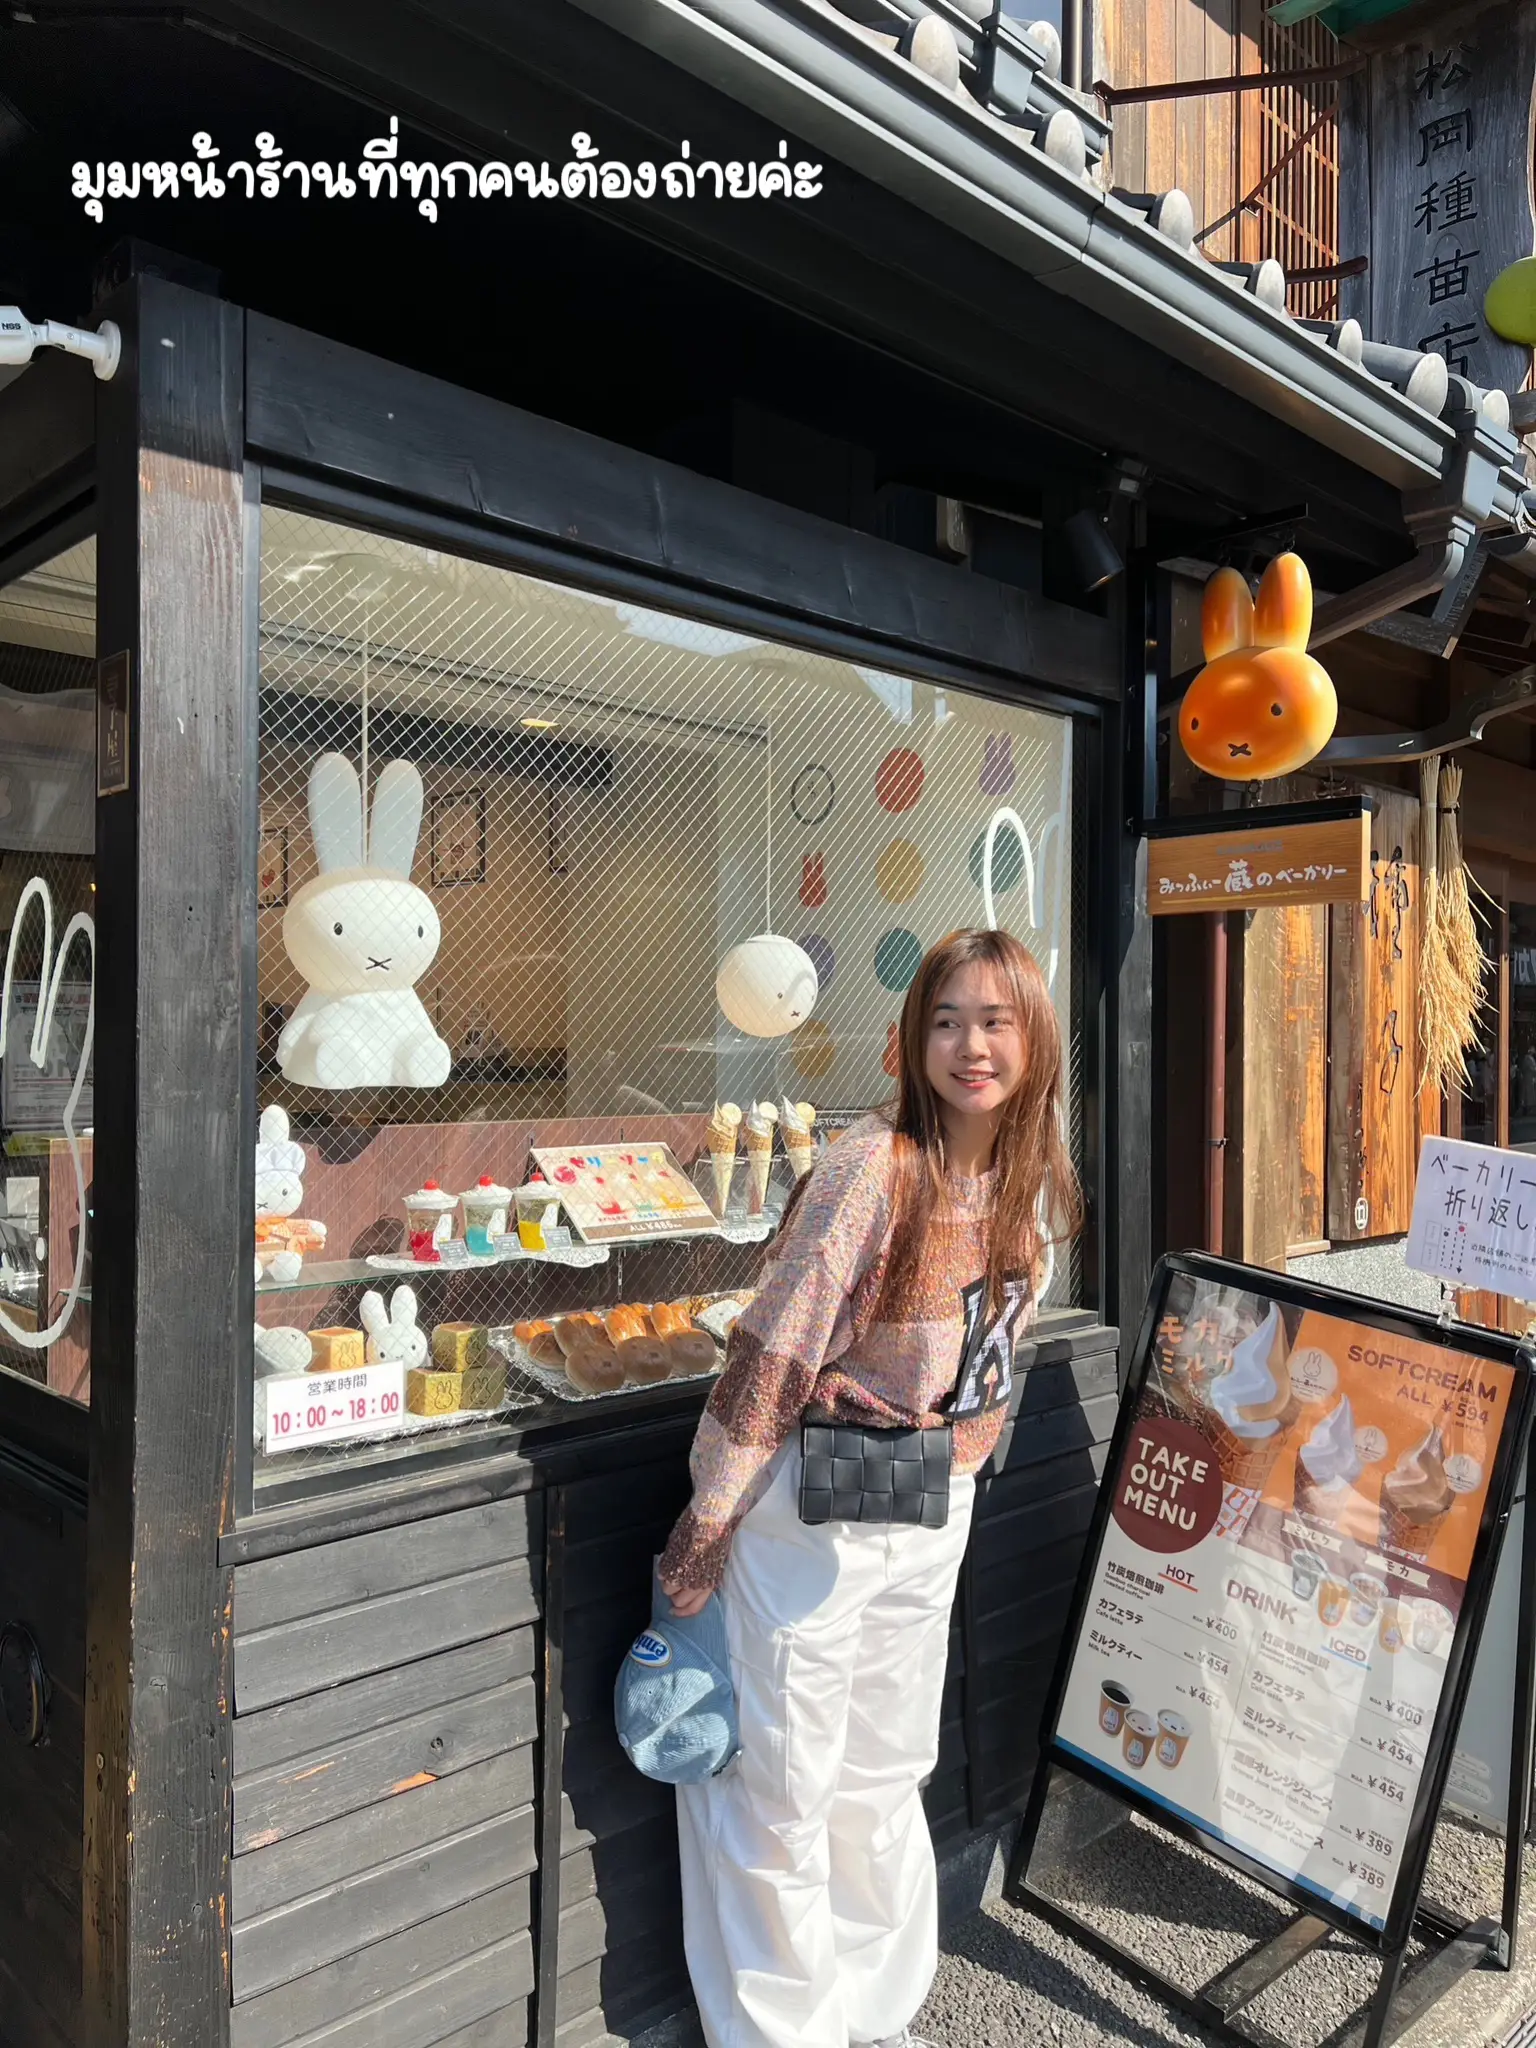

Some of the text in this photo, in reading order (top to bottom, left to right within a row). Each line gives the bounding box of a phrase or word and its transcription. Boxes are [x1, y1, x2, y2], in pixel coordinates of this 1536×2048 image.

[2, 322, 22, 331] NSS
[307, 1373, 368, 1396] 営業時間
[1346, 1343, 1498, 1403] SOFTCREAM
[1396, 1383, 1432, 1405] ALL
[1134, 1436, 1209, 1484] TAKE
[1128, 1460, 1184, 1501] OUT
[1122, 1483, 1197, 1533] MENU
[1165, 1563, 1194, 1585] HOT
[1098, 1596, 1144, 1627] カフェラテ
[1225, 1578, 1297, 1625] DRINK
[1089, 1628, 1143, 1664] ミルクティー
[1329, 1636, 1366, 1663] ICED
[1243, 1705, 1307, 1747] ミルクティー
